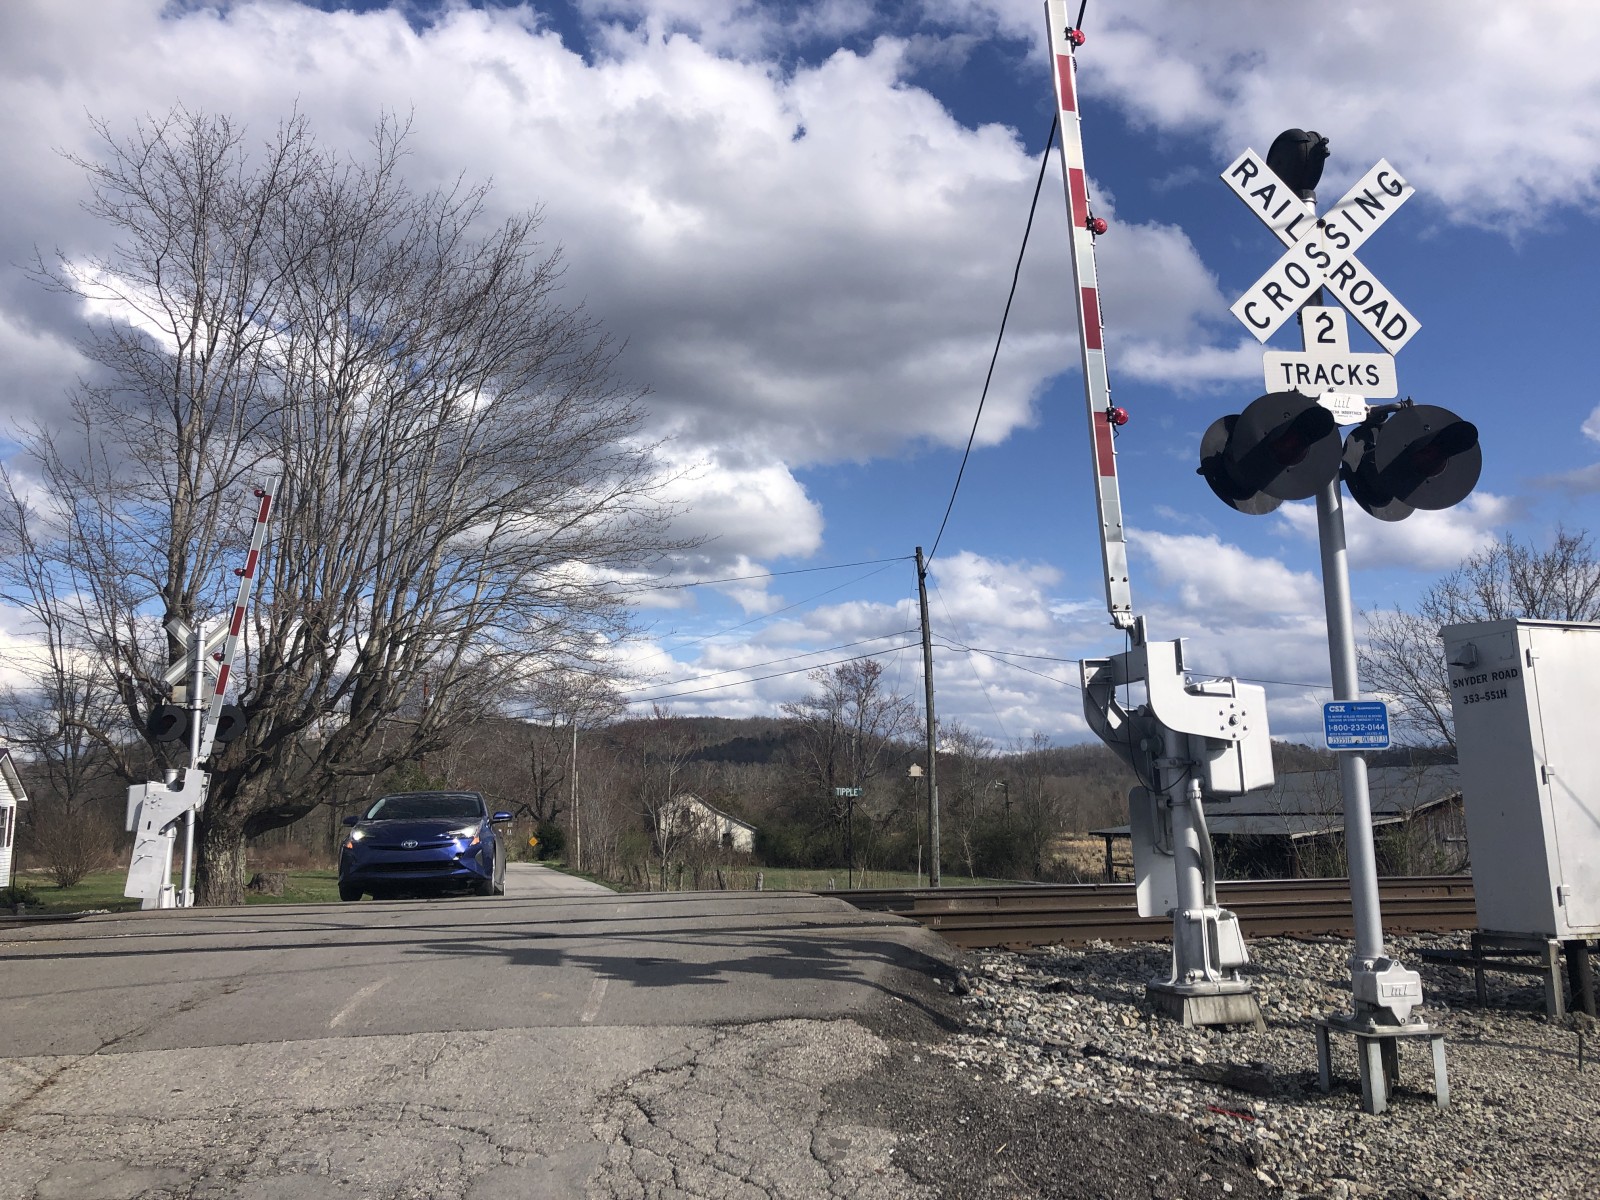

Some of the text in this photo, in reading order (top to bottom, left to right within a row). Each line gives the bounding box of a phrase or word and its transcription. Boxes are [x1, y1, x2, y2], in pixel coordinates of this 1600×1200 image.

[1243, 170, 1403, 330] CROSSING
[1315, 311, 1336, 344] 2
[1280, 363, 1380, 386] TRACKS
[1453, 669, 1518, 688] SNYDER ROAD
[1463, 689, 1507, 704] 353-551H
[836, 788, 858, 796] TIPPLE
